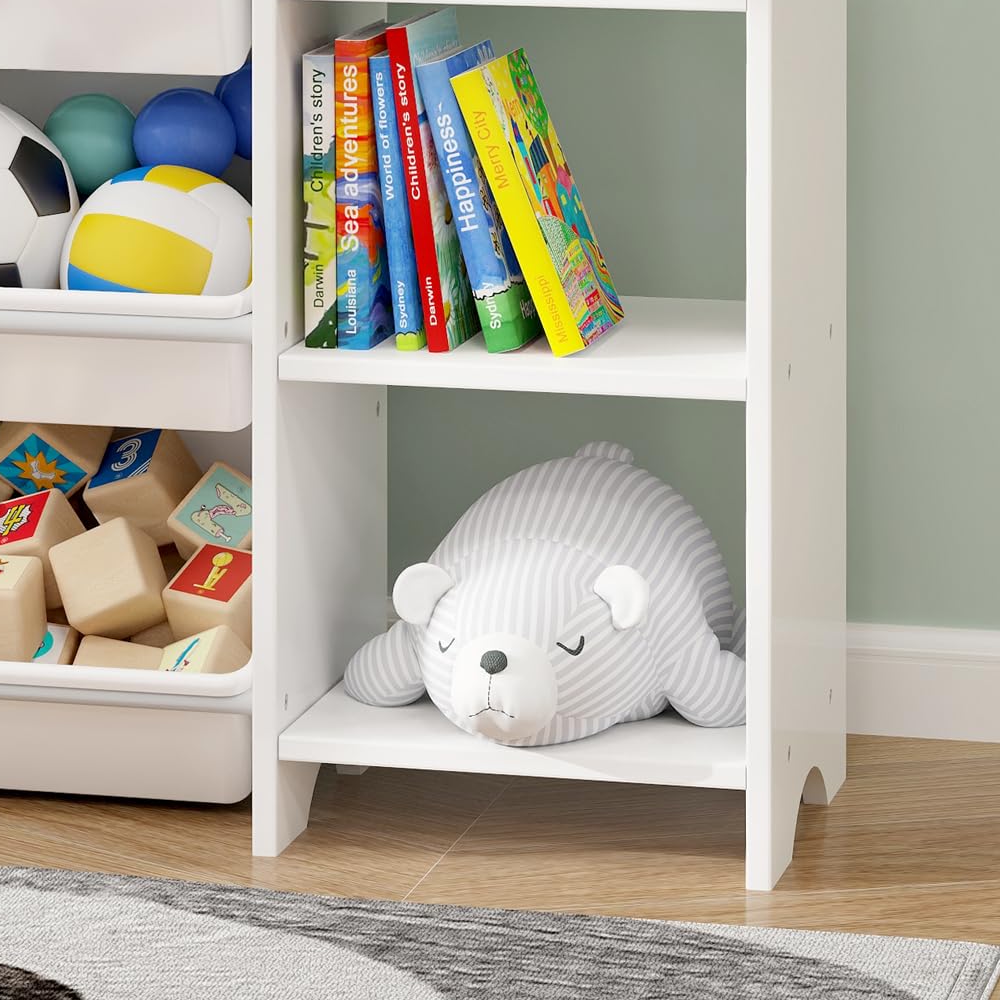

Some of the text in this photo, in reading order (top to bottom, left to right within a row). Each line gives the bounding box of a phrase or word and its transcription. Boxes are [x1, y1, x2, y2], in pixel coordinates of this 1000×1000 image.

[310, 69, 326, 192] Children's story
[340, 65, 359, 252] Sea adventures
[376, 71, 395, 201] World of flowers
[396, 62, 421, 200] Children's story
[472, 111, 510, 189] Merry City
[437, 113, 479, 232] Happiness
[313, 264, 324, 308] Darwin
[345, 269, 357, 334] Louisiana
[397, 280, 408, 329] Sydney
[425, 276, 438, 326] Darwin
[535, 274, 568, 343] Mississippi
[111, 438, 142, 472] 3
[3, 504, 25, 536] 4
